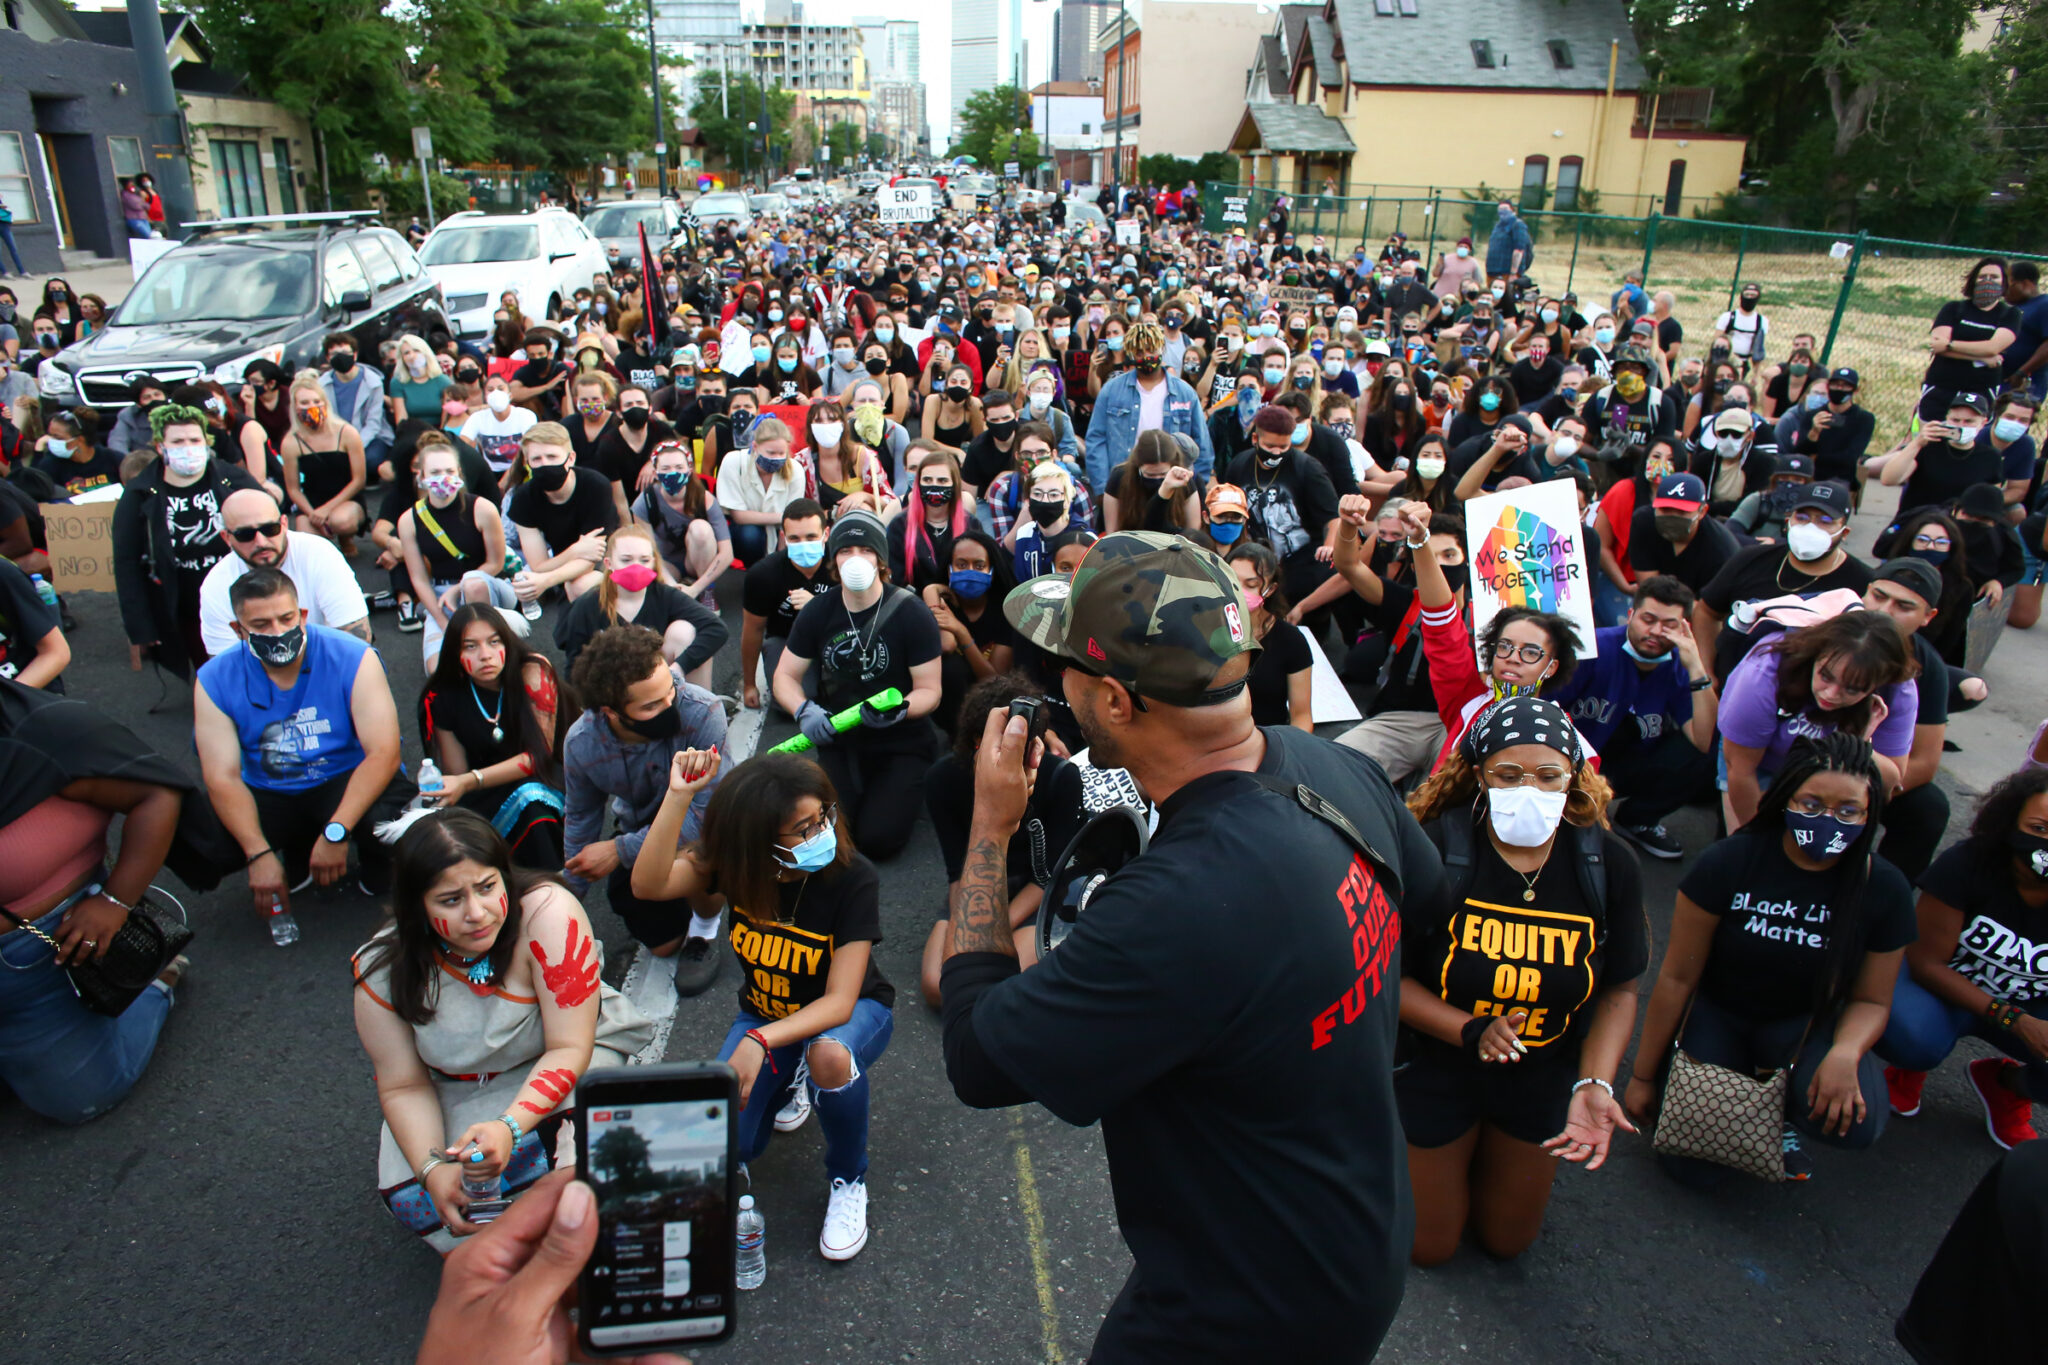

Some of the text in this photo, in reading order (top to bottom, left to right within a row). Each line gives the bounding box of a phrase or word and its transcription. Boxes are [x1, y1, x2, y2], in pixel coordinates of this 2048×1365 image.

[895, 190, 918, 202] END
[882, 207, 930, 220] BRUTALITY
[631, 370, 656, 380] BLAC
[46, 517, 83, 541] NO
[59, 557, 98, 577] NO
[1478, 535, 1574, 567] We Stand
[1480, 564, 1579, 592] TOGETHER
[1115, 770, 1145, 810] AGAIN
[1352, 882, 1390, 970] OUR
[1461, 914, 1581, 967] EQUITY
[1744, 915, 1830, 949] Matte
[732, 922, 823, 975] EQUITY
[1964, 920, 2048, 975] BLAC
[753, 969, 790, 997] OR
[1311, 911, 1401, 1051] FUTUR
[1492, 963, 1541, 1003] OR
